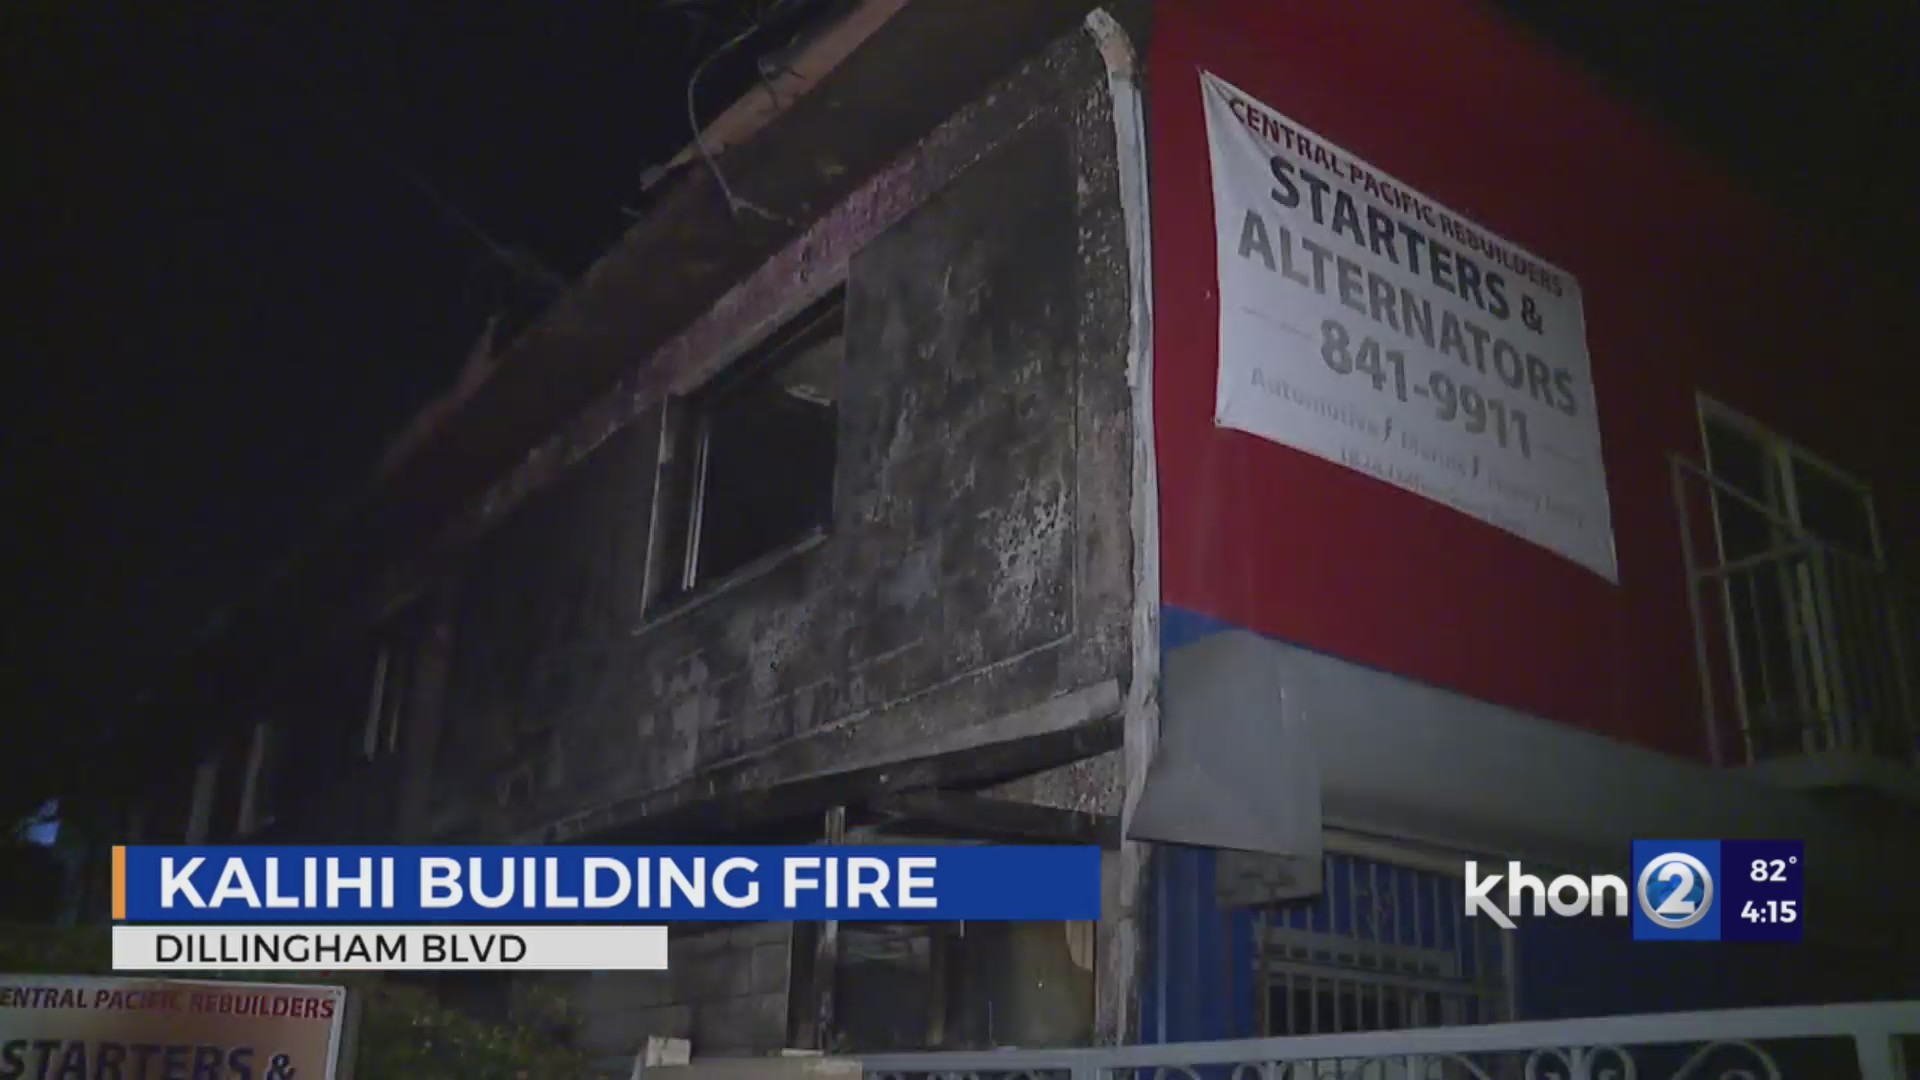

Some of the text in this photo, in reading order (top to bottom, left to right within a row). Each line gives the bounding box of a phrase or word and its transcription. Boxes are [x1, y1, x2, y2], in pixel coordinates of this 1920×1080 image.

[1229, 98, 1563, 298] CENTRAL PACIFIC REBUILDERS
[1270, 155, 1545, 335] STARTERS &
[1237, 208, 1577, 417] ALTERNATORS
[1320, 318, 1531, 460] 841-9911
[0, 987, 87, 1009] ENTRAL
[190, 994, 335, 1018] REBUILDERS
[0, 1039, 254, 1080] STARTERS
